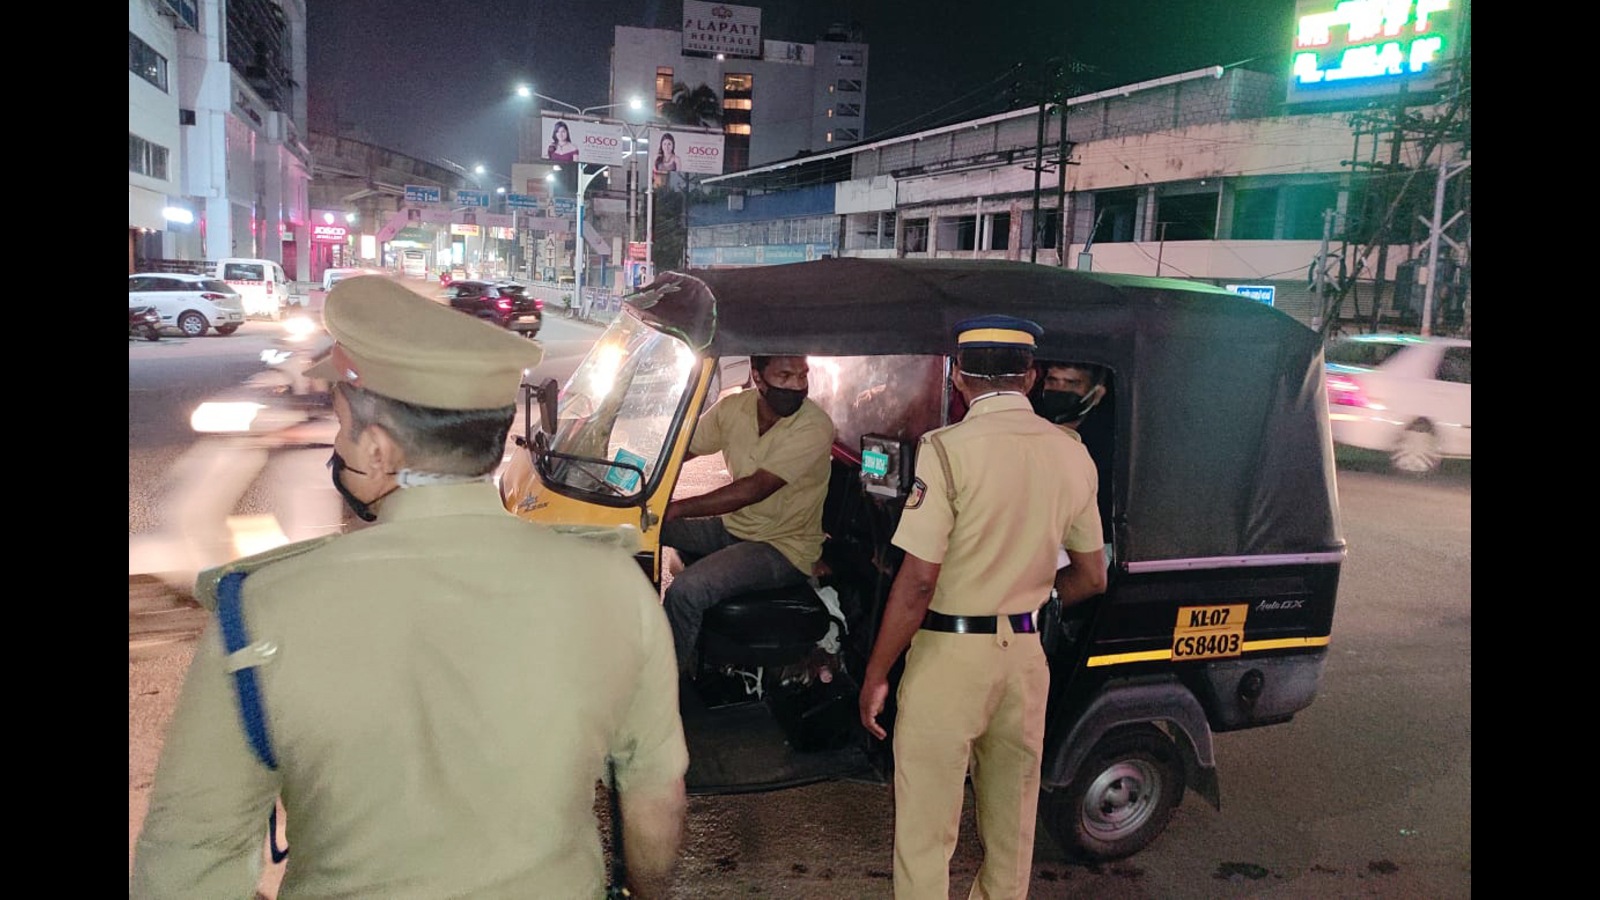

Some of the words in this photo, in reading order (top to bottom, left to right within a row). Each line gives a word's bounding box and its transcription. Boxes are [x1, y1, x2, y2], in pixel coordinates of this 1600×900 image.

[691, 33, 752, 46] HERITAGE
[583, 135, 618, 147] JOSCO
[688, 146, 719, 156] JOSCO
[314, 226, 346, 236] JOSCO
[1189, 608, 1230, 628] KL-07
